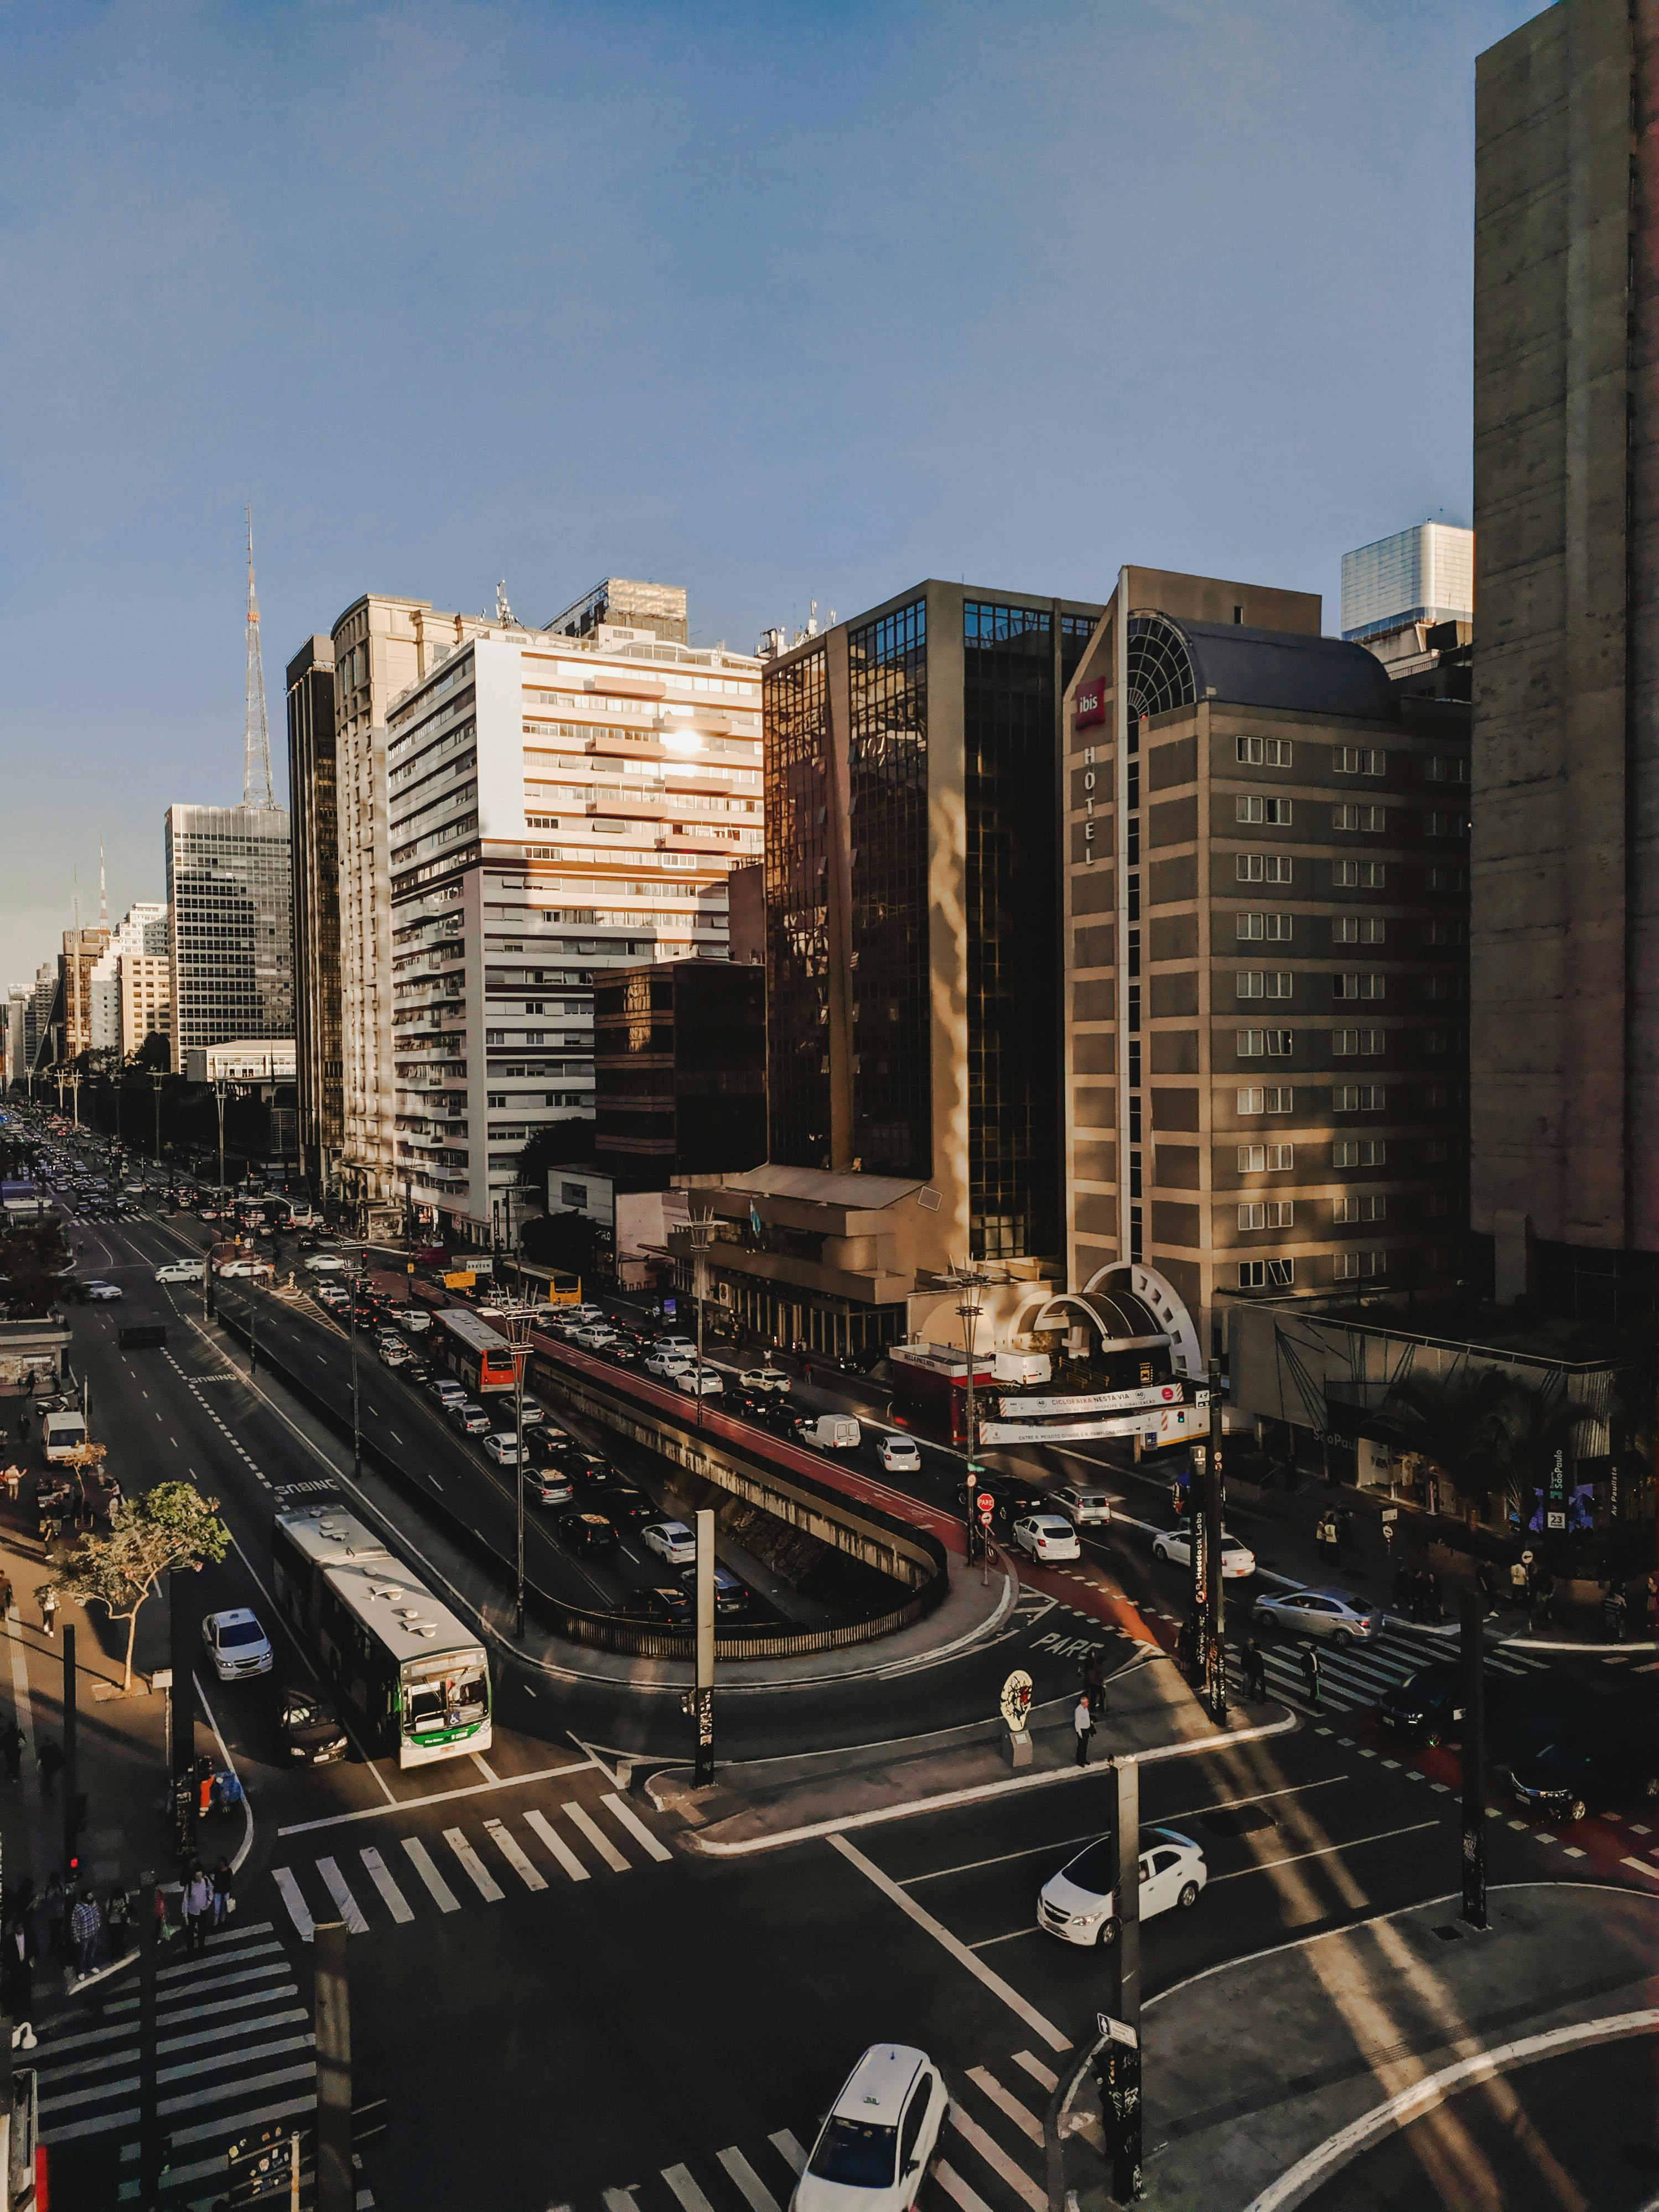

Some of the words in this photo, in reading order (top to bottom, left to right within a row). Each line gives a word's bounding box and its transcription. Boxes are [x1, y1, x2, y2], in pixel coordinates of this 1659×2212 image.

[1080, 693, 1098, 713] ibis
[1084, 746, 1096, 866] HOTEL
[917, 1357, 935, 1368] PAULISTA
[1554, 1450, 1563, 1489] SãoPaulo
[1551, 1515, 1563, 1524] 23
